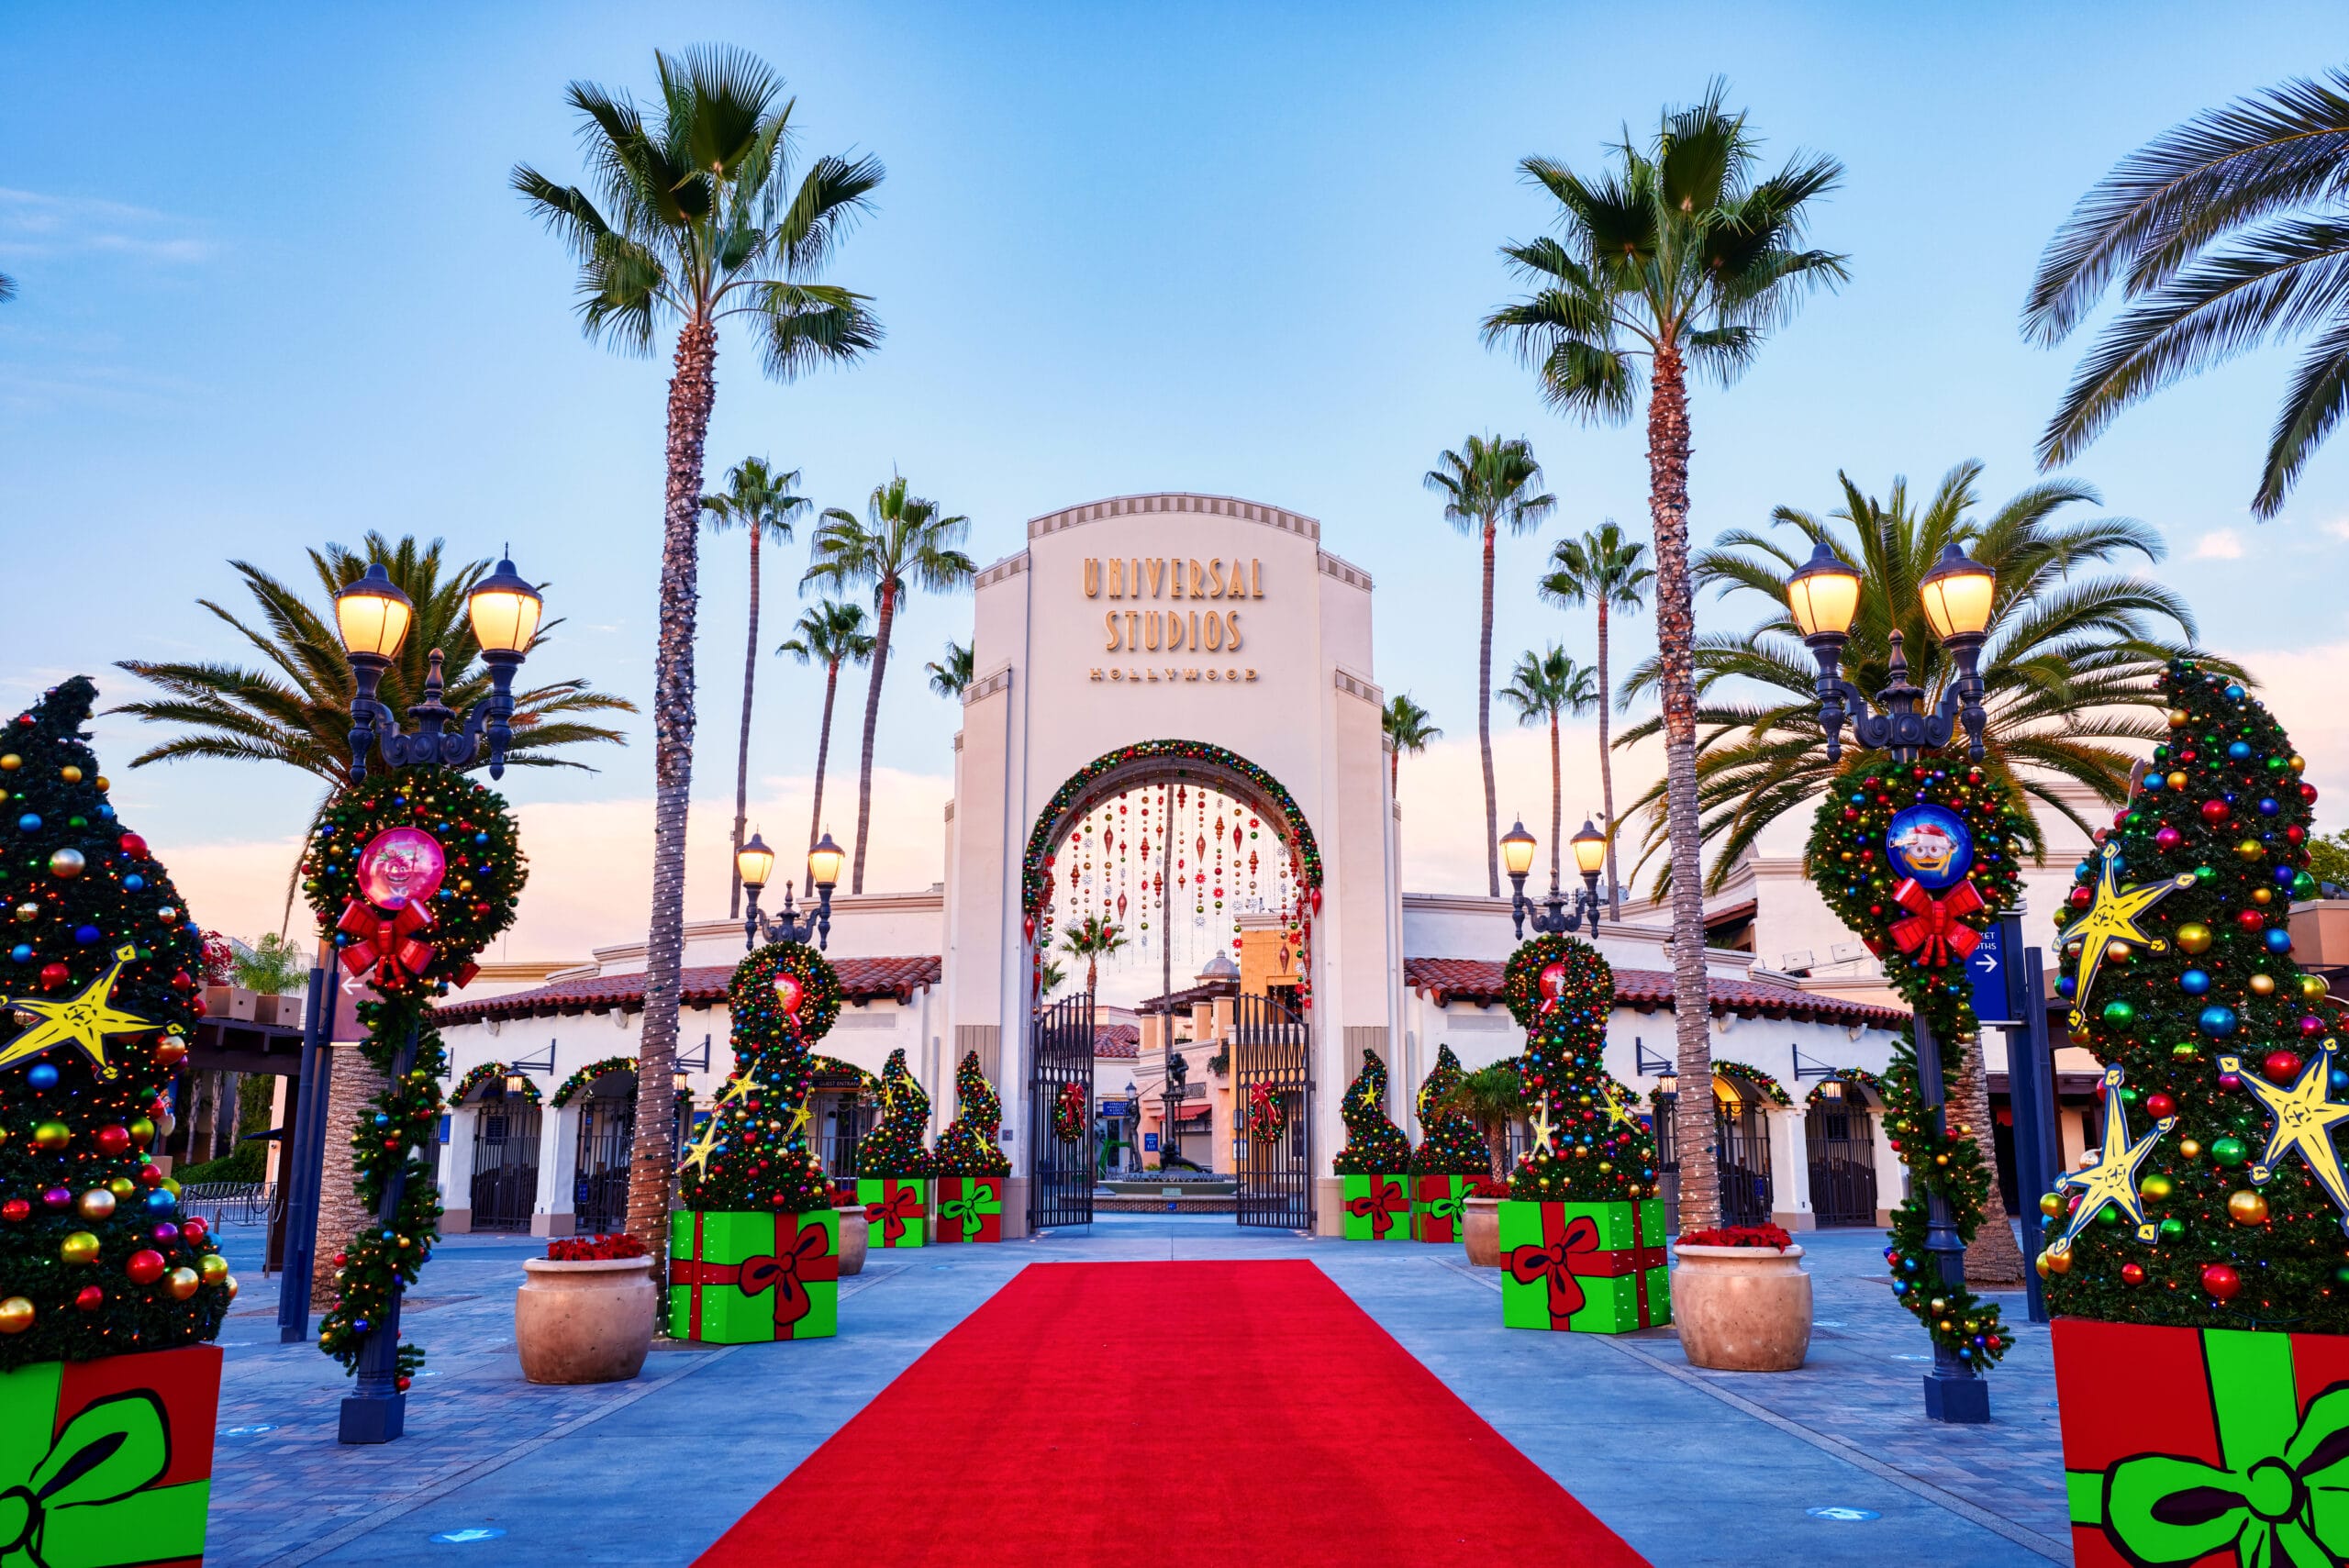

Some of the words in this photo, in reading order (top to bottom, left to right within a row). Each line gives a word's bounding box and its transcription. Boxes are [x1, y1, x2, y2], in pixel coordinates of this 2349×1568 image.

[1084, 558, 1264, 598] UNIVERSAL
[1105, 610, 1241, 651] STUDIOS
[1089, 668, 1259, 682] HOLLYWOOD
